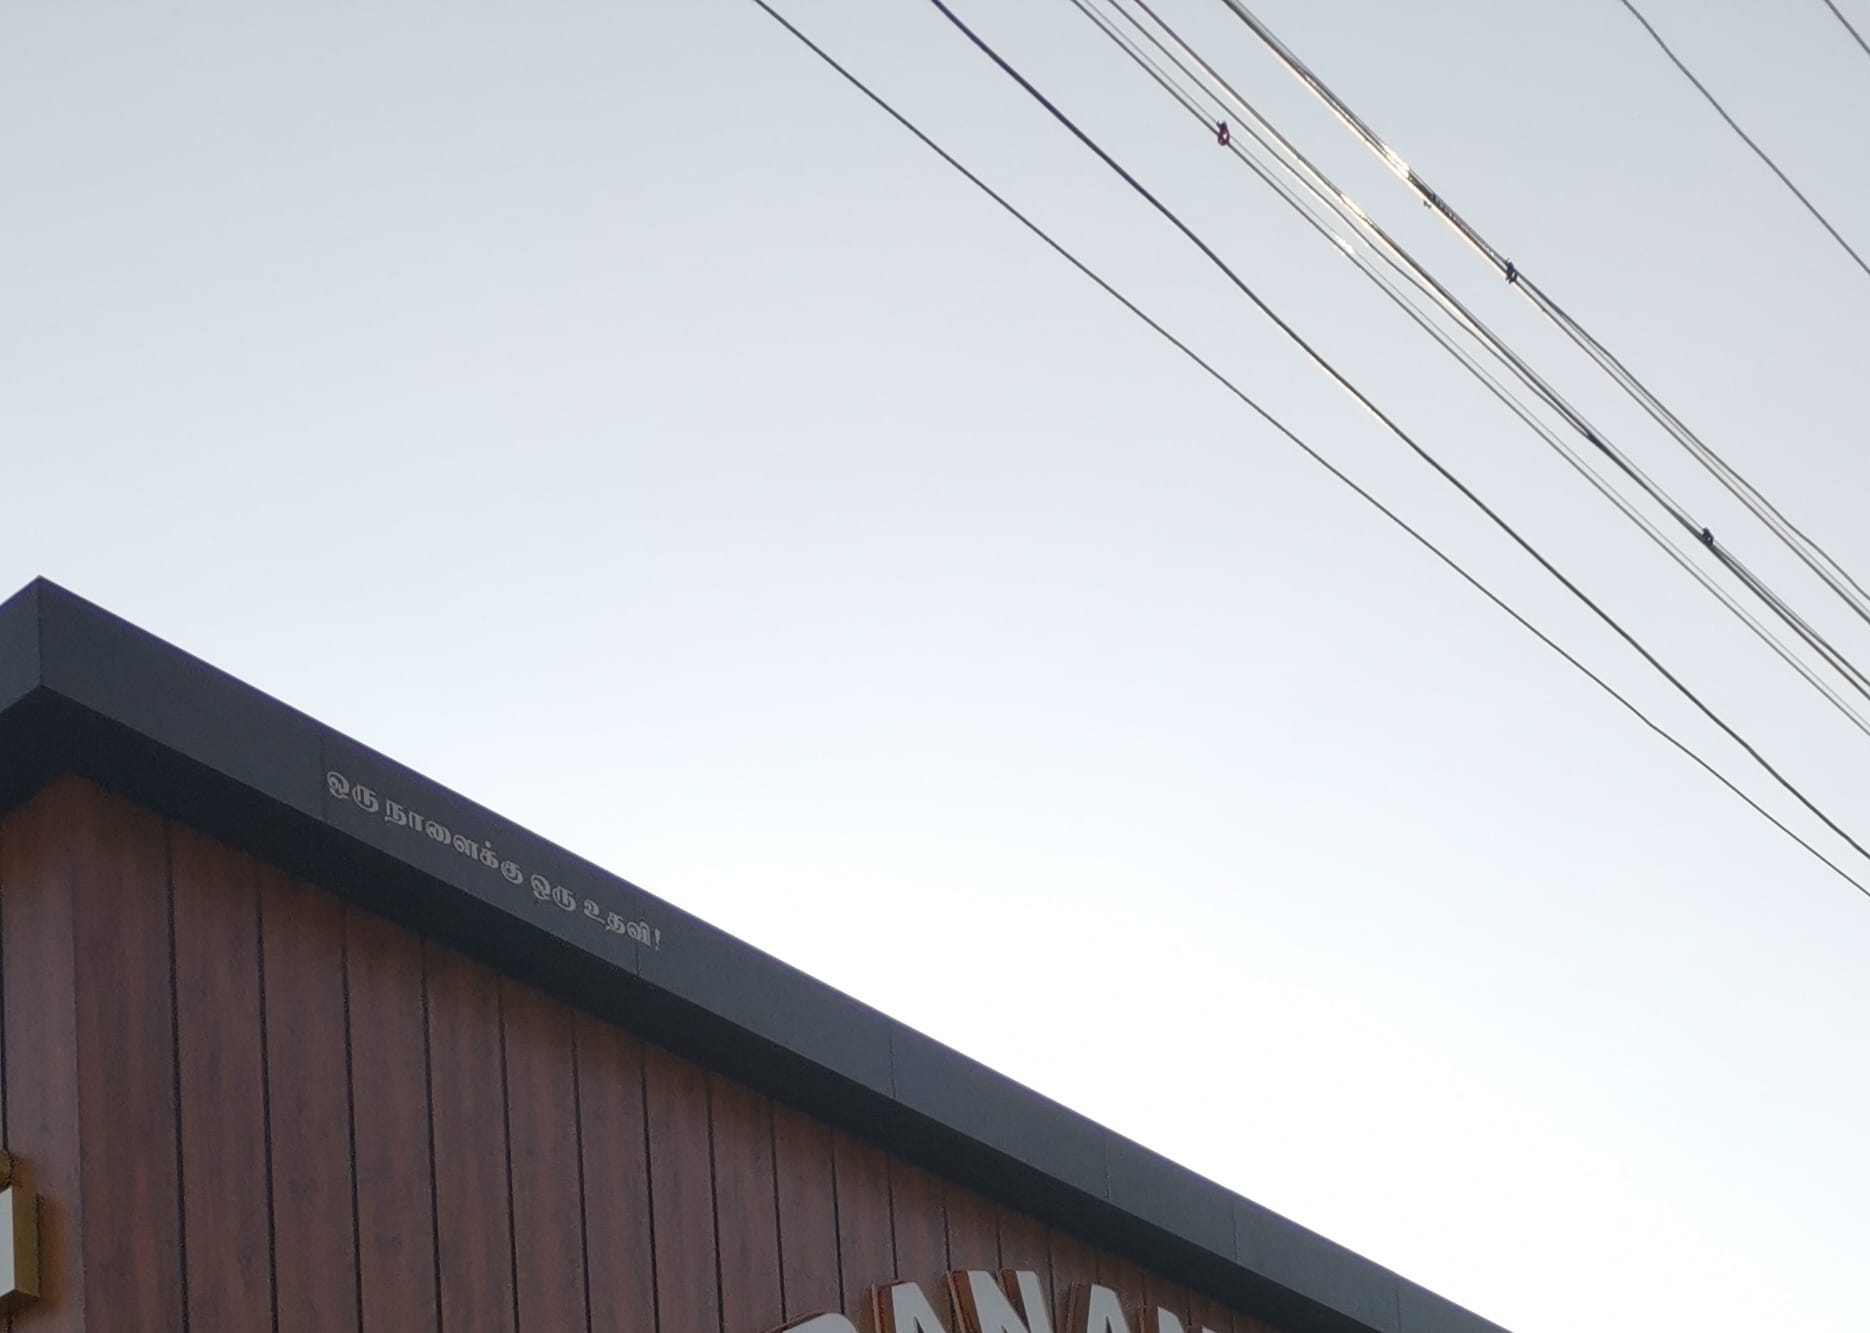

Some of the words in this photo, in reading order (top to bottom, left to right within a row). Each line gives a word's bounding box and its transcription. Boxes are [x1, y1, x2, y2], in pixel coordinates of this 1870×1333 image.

[326, 770, 379, 814] ஒரு
[384, 799, 524, 885] நாளைக்கு
[530, 874, 576, 912] ஒரு
[583, 899, 662, 951] உதவி!
